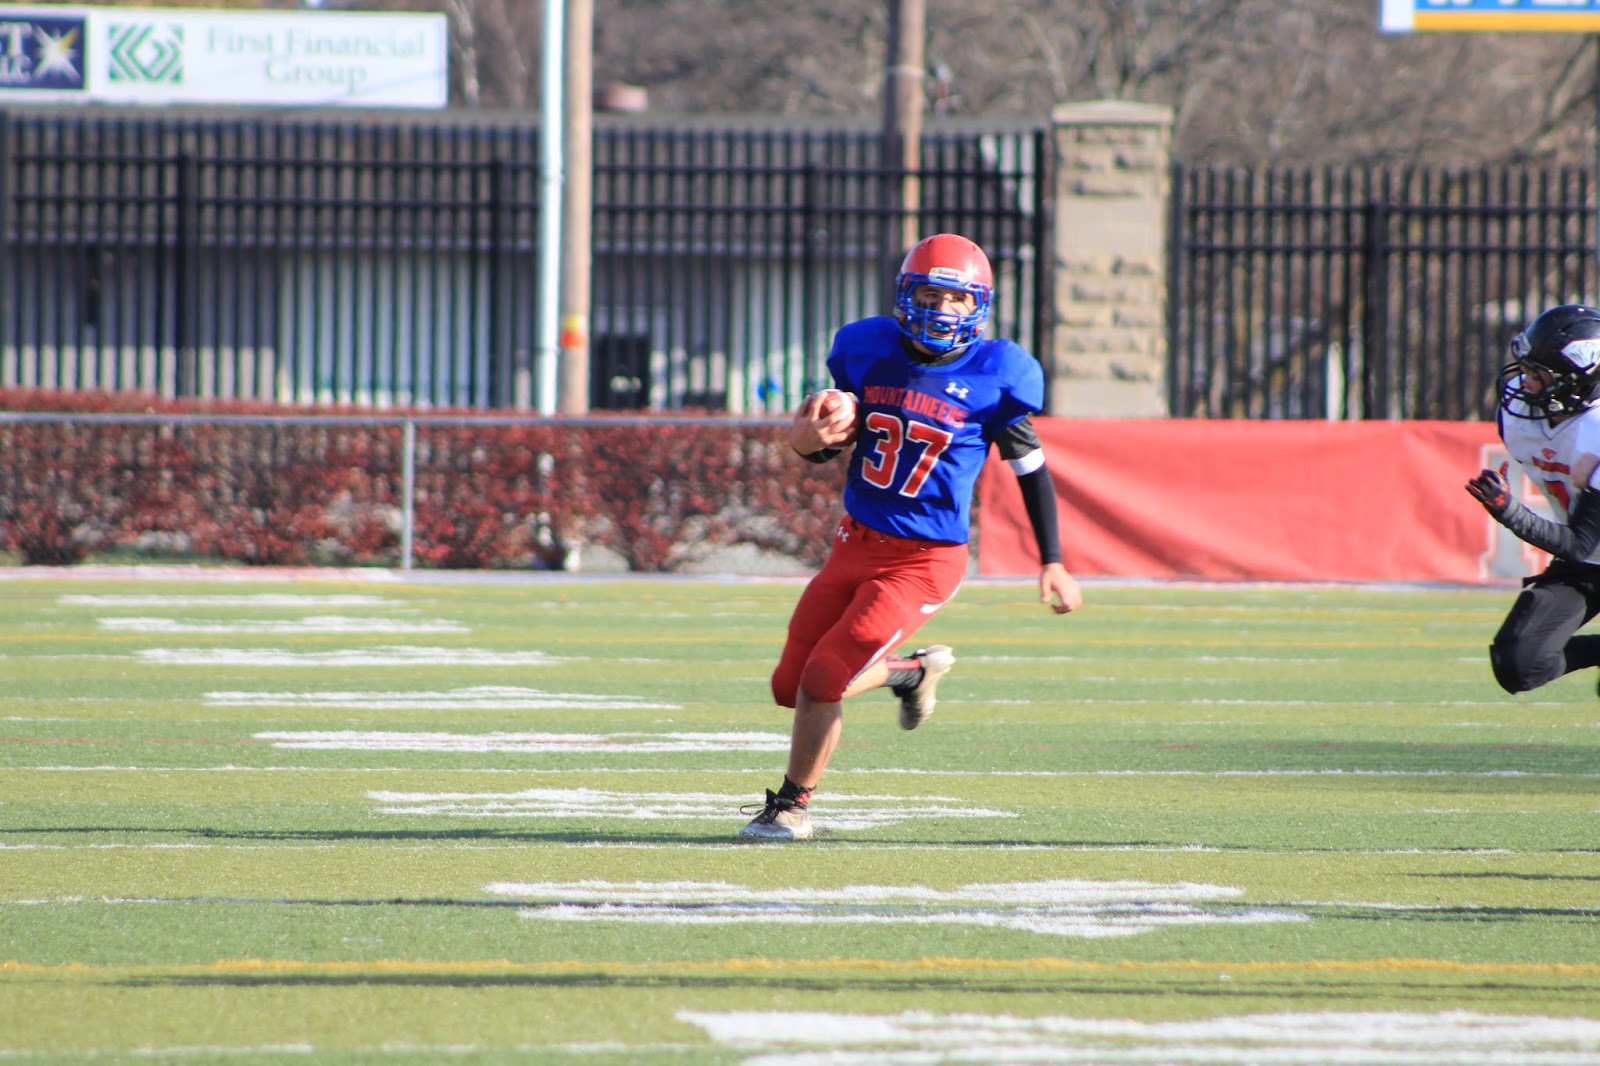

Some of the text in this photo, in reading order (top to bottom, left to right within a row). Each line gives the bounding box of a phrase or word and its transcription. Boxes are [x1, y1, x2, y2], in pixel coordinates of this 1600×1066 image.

[206, 26, 426, 58] First Financial
[264, 56, 370, 96] Group
[863, 385, 970, 429] MOUNTAINEERS
[861, 411, 954, 498] 37
